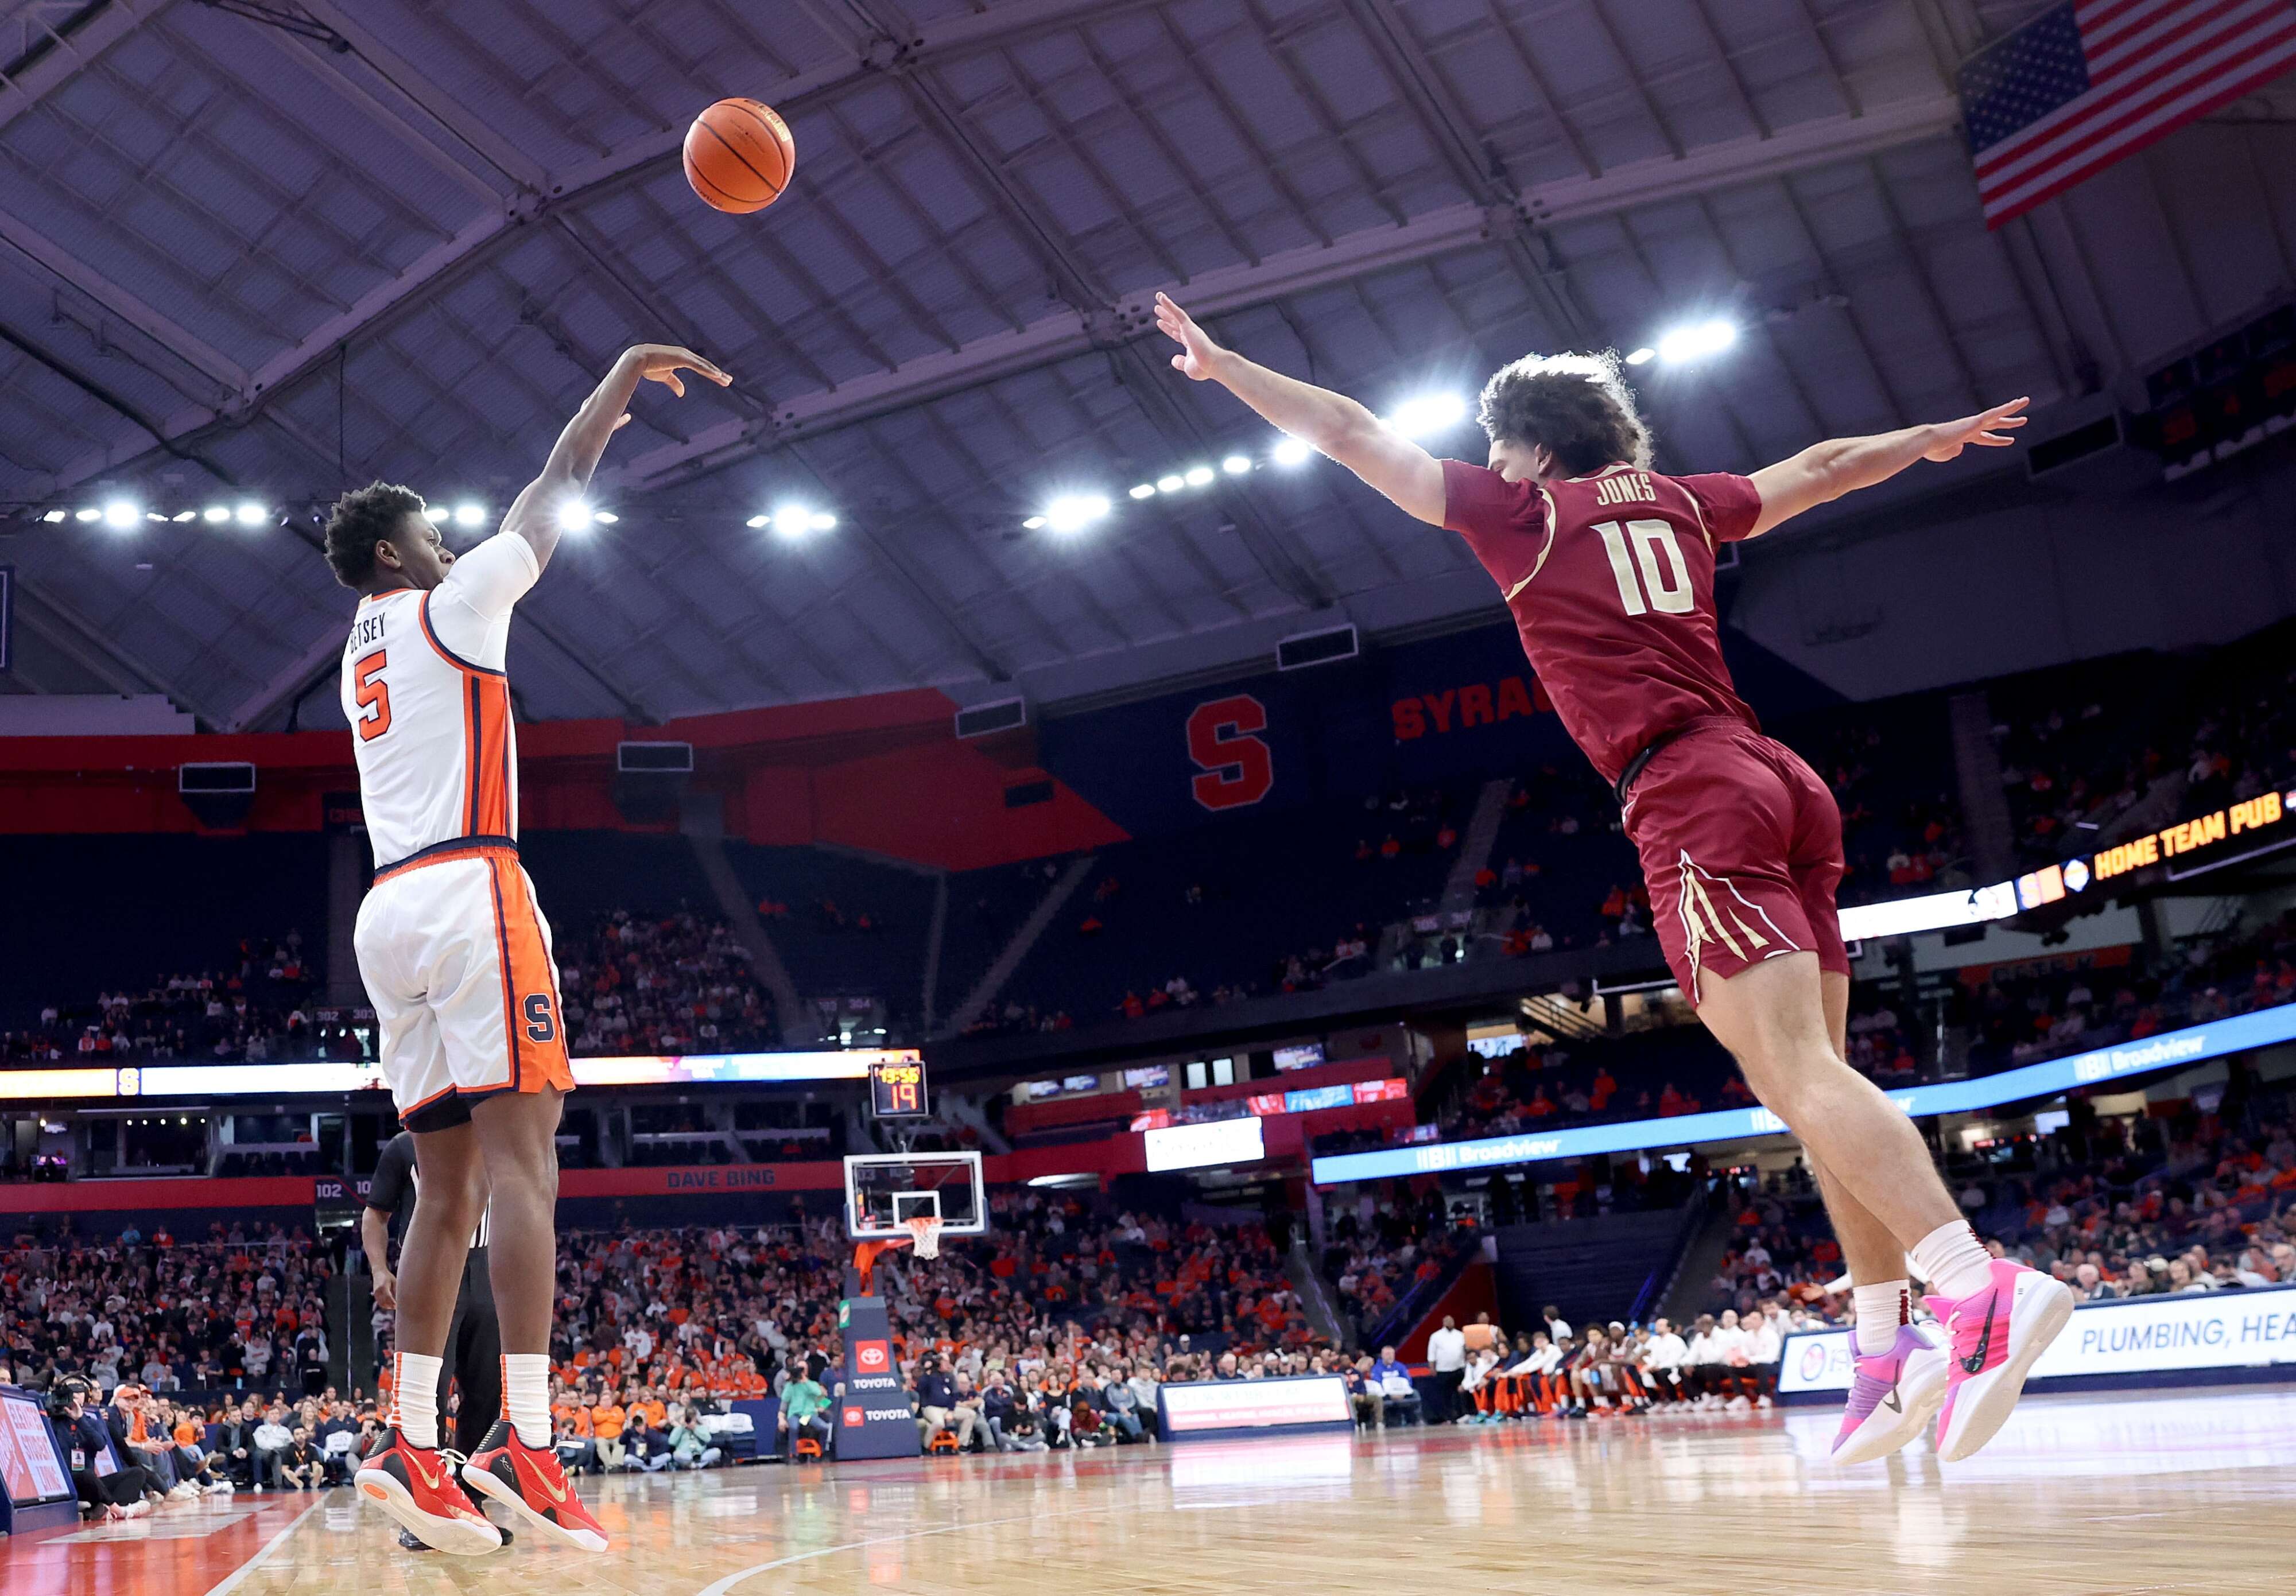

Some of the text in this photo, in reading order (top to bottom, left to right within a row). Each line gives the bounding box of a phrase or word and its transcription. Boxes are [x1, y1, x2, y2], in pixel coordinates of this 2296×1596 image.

[1596, 473, 1657, 506] JONES
[1589, 519, 1694, 616] 10
[355, 649, 391, 742] 5
[1186, 693, 1274, 812] S
[2094, 791, 2282, 880] HOME TEAM PUB
[316, 1011, 339, 1021] 302
[523, 993, 555, 1043] S
[2111, 1035, 2205, 1071] Broadview
[118, 1067, 139, 1096] S
[879, 1067, 920, 1084] 13:56
[891, 1083, 917, 1110] 19
[1459, 1139, 1560, 1163] Broadview
[316, 1184, 342, 1197] 102
[356, 1180, 372, 1194] 10
[668, 1169, 775, 1187] DAVE BING
[2081, 1319, 2230, 1354] PLUMBING,
[853, 1378, 896, 1389] TOYOTA
[866, 1408, 910, 1421] TOYOTA
